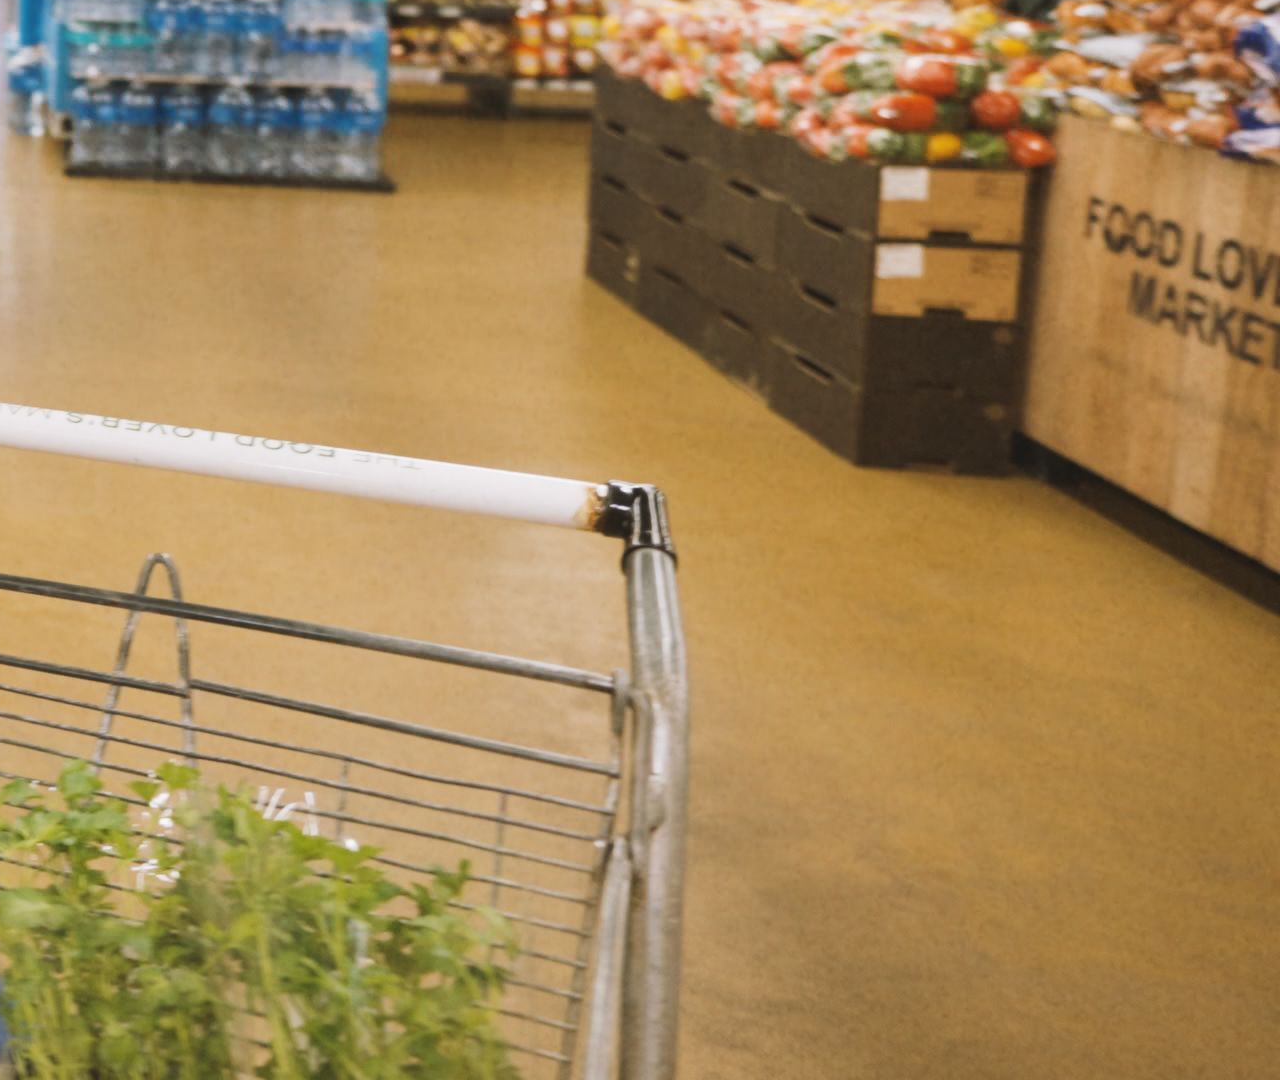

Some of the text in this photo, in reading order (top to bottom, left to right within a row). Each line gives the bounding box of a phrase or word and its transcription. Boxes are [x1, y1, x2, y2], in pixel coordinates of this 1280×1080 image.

[1083, 195, 1280, 307] FOOD LOV
[1127, 270, 1280, 372] MARKET
